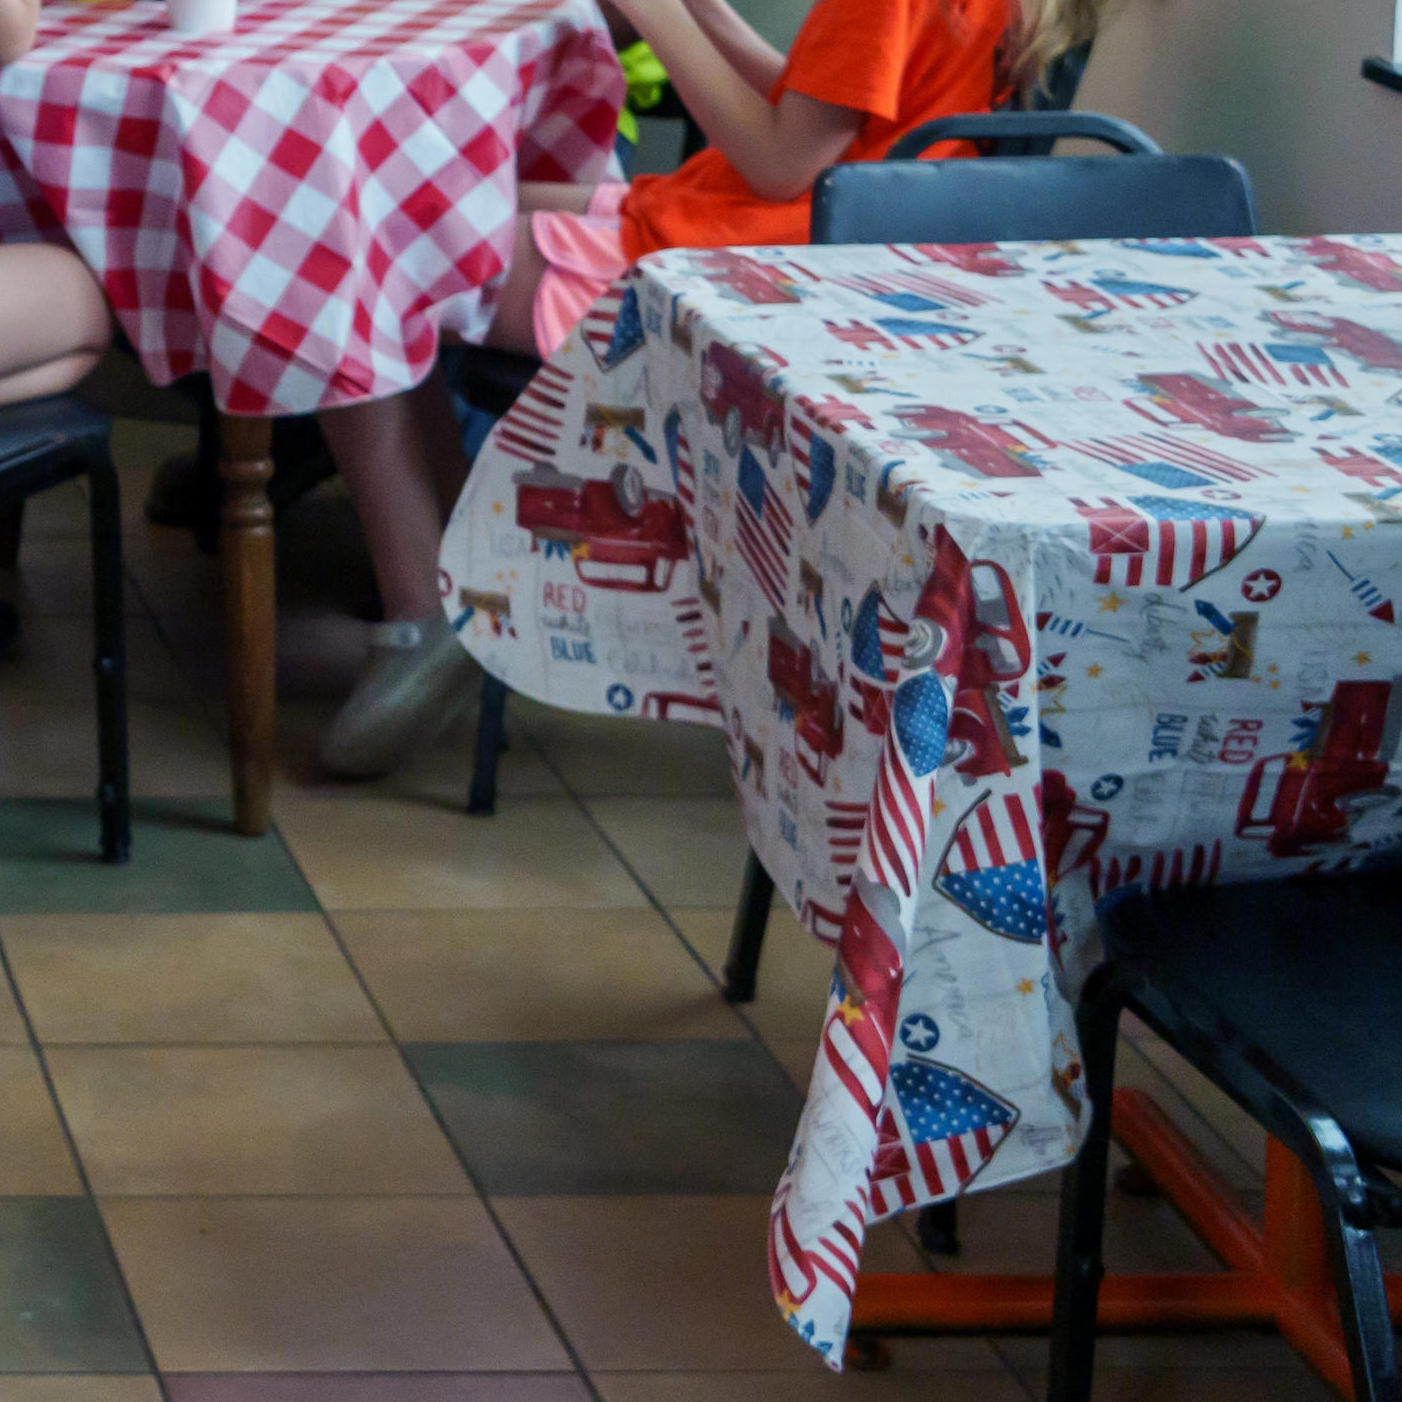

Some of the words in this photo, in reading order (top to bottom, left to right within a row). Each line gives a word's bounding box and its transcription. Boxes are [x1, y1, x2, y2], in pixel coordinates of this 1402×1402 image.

[543, 581, 587, 613] RED
[1149, 713, 1188, 763] BLUE
[1217, 718, 1264, 765] RED
